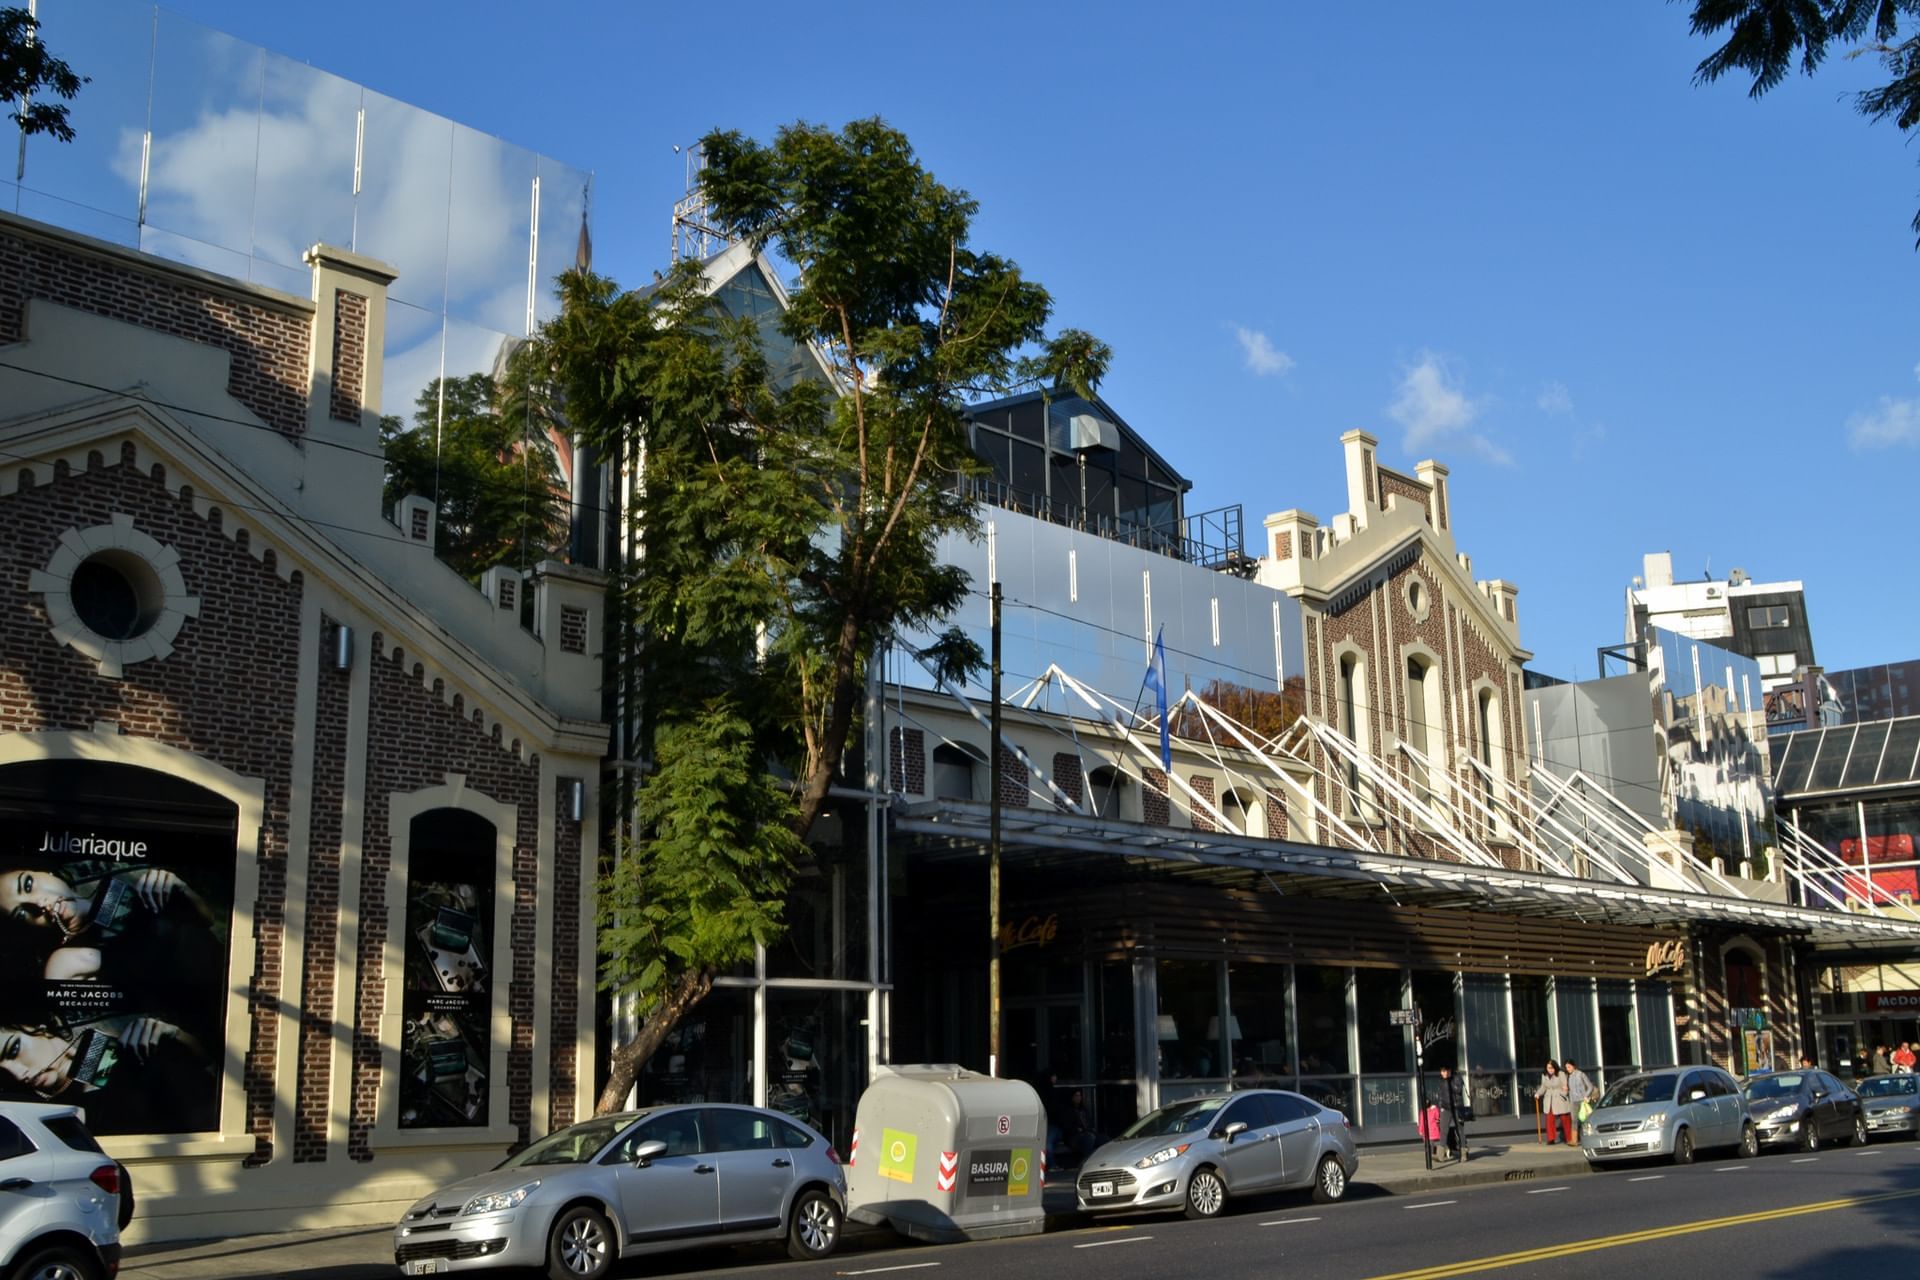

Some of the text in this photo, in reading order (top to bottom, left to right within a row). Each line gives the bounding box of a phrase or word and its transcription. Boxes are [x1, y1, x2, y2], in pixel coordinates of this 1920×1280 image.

[39, 830, 148, 862] Juleriaque
[46, 990, 125, 1000] MARC JACOBS
[58, 1000, 111, 1008] DECADENCE
[426, 998, 445, 1006] MARC
[970, 1162, 1010, 1175] BASURA
